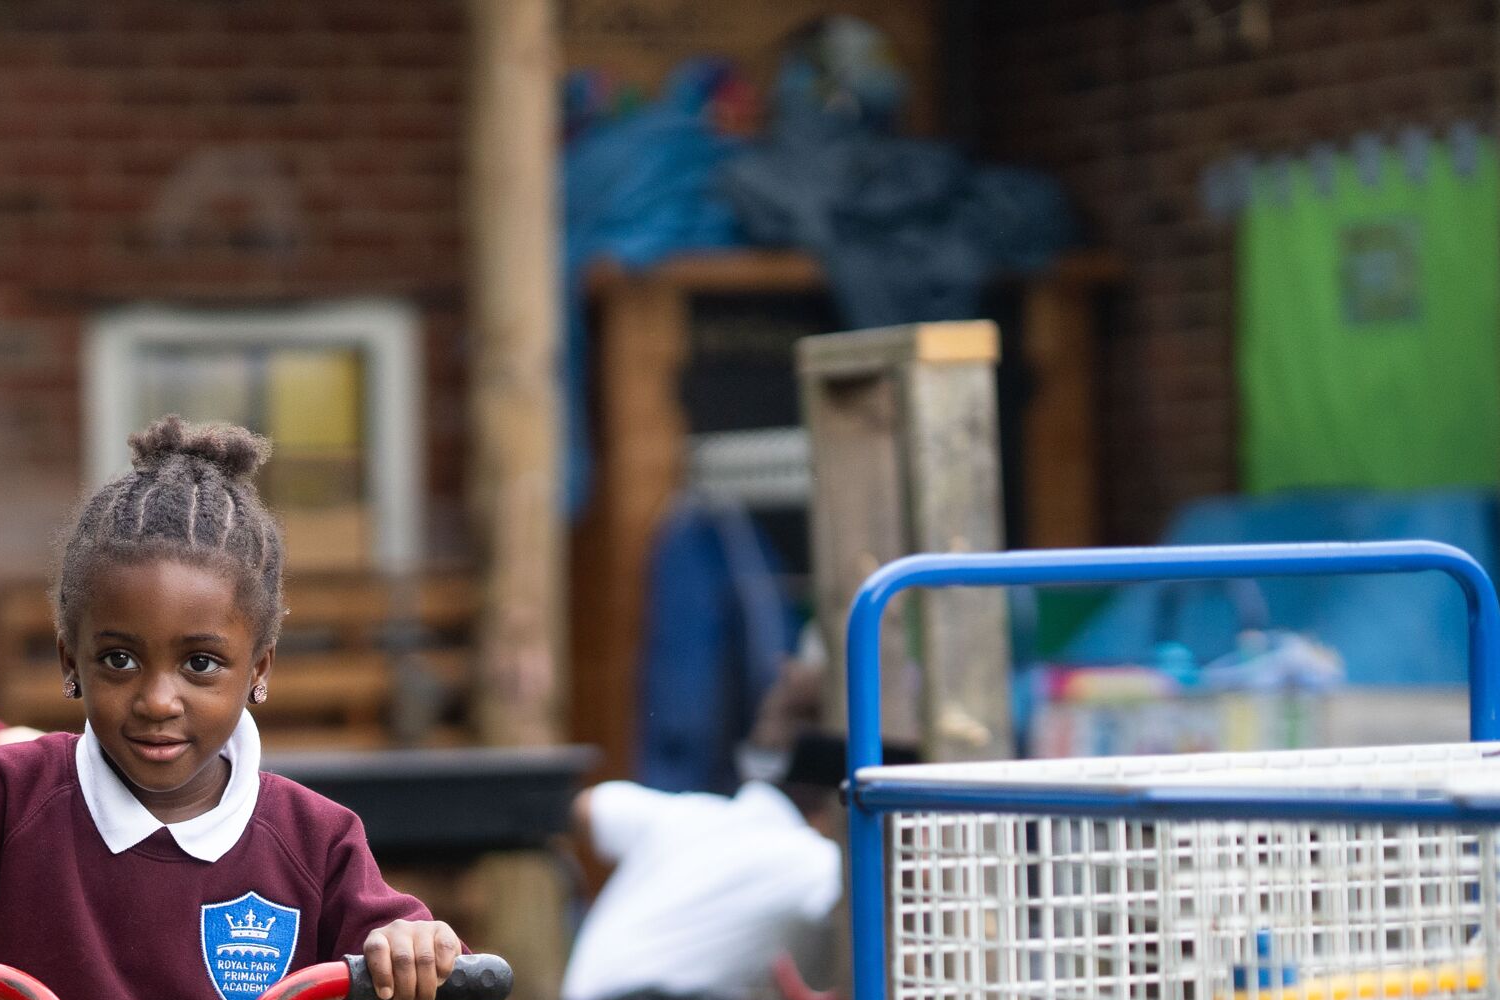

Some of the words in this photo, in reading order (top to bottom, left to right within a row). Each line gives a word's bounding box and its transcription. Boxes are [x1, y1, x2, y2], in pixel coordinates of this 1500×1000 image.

[217, 960, 249, 969] ROYAL
[251, 962, 276, 971] PARK
[224, 971, 269, 982] PRIMARY
[223, 982, 269, 992] ACADEMY
